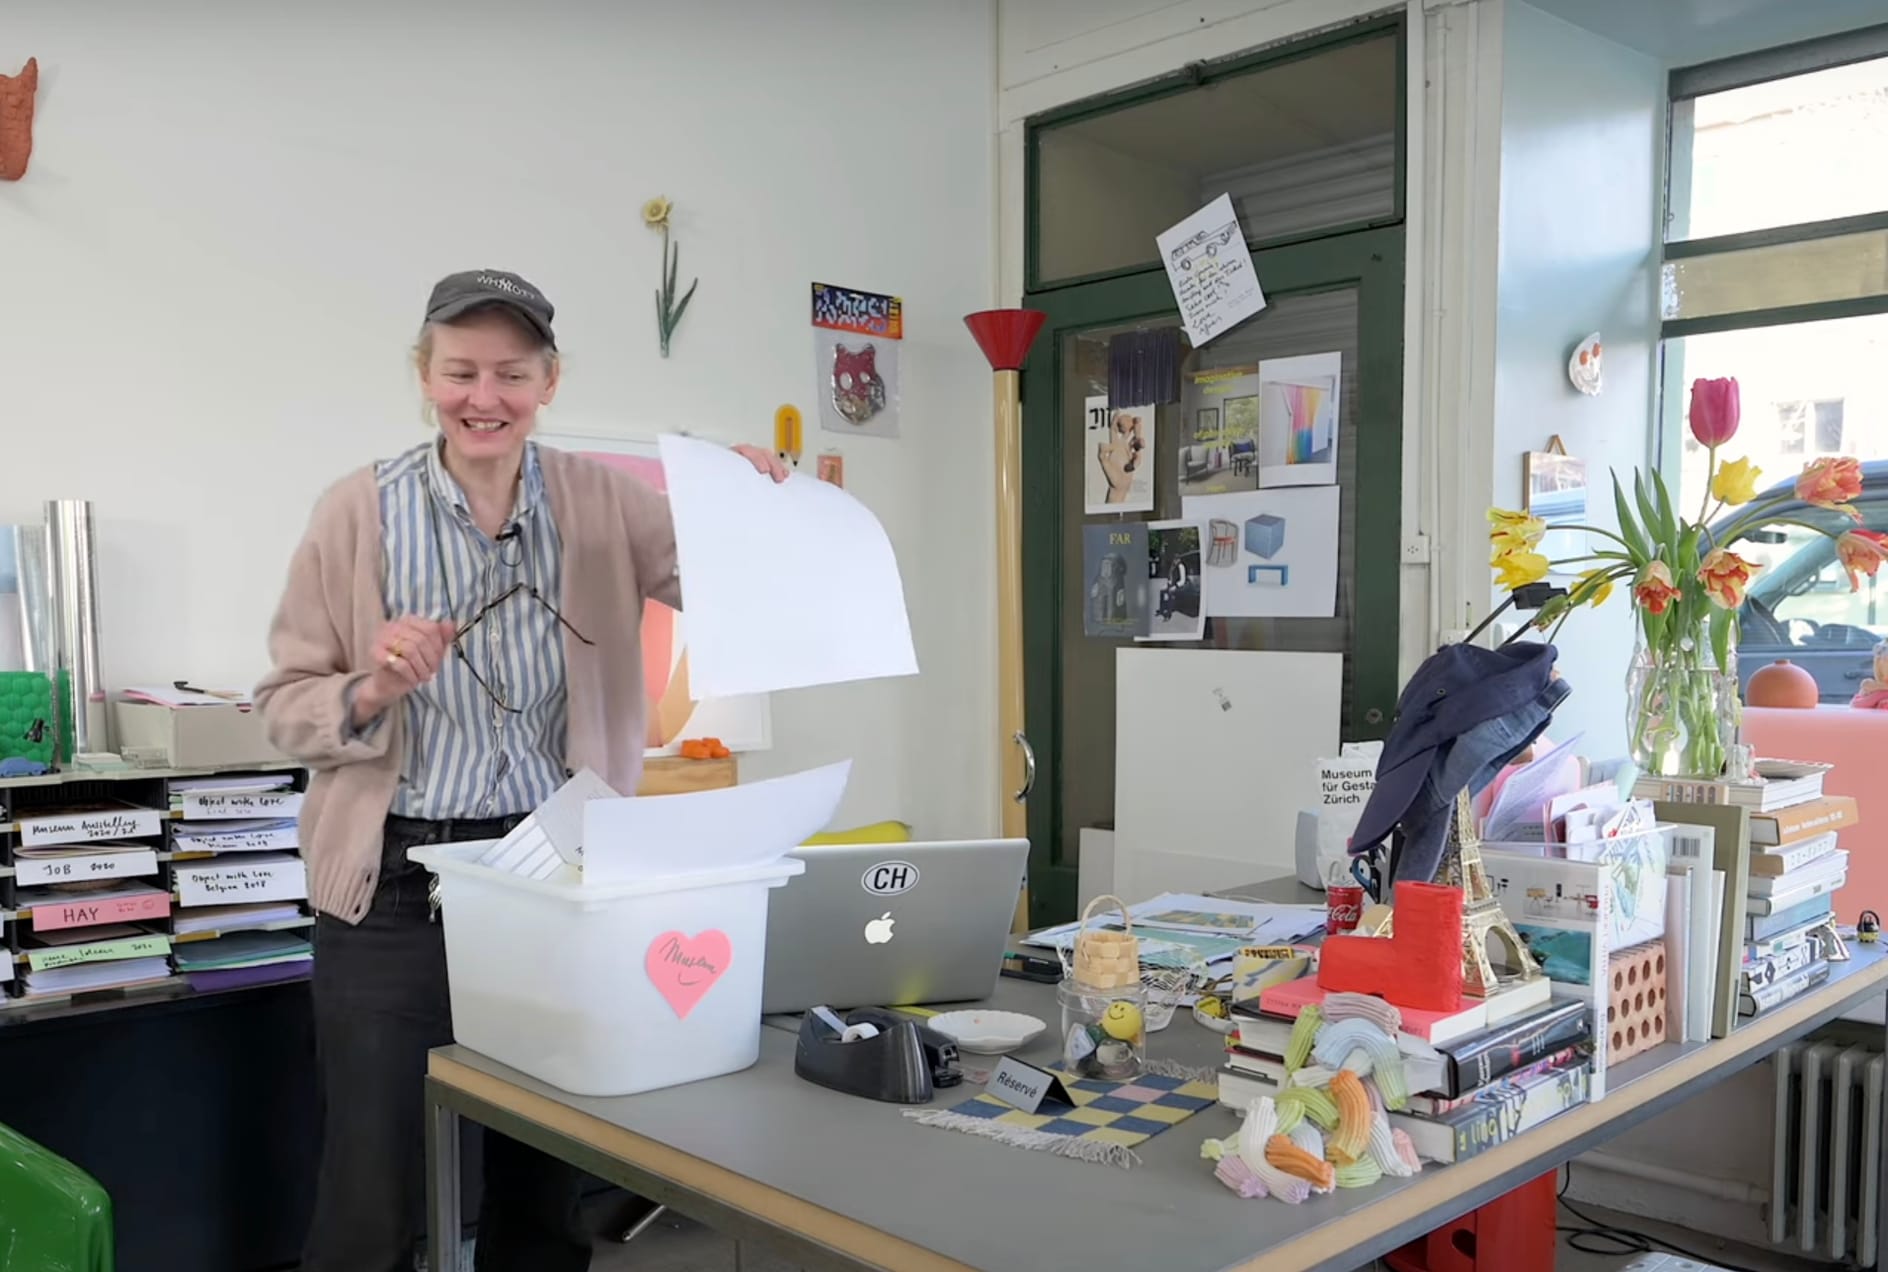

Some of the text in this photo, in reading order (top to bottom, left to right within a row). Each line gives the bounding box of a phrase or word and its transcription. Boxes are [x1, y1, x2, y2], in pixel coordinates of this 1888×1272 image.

[1109, 532, 1132, 545] FAR
[1321, 769, 1373, 779] Museum
[1322, 782, 1338, 792] für
[1323, 793, 1361, 805] Zürich
[32, 824, 76, 836] Museum
[873, 867, 908, 890] CH
[63, 907, 99, 923] HAY
[997, 1071, 1039, 1098] Réservé
